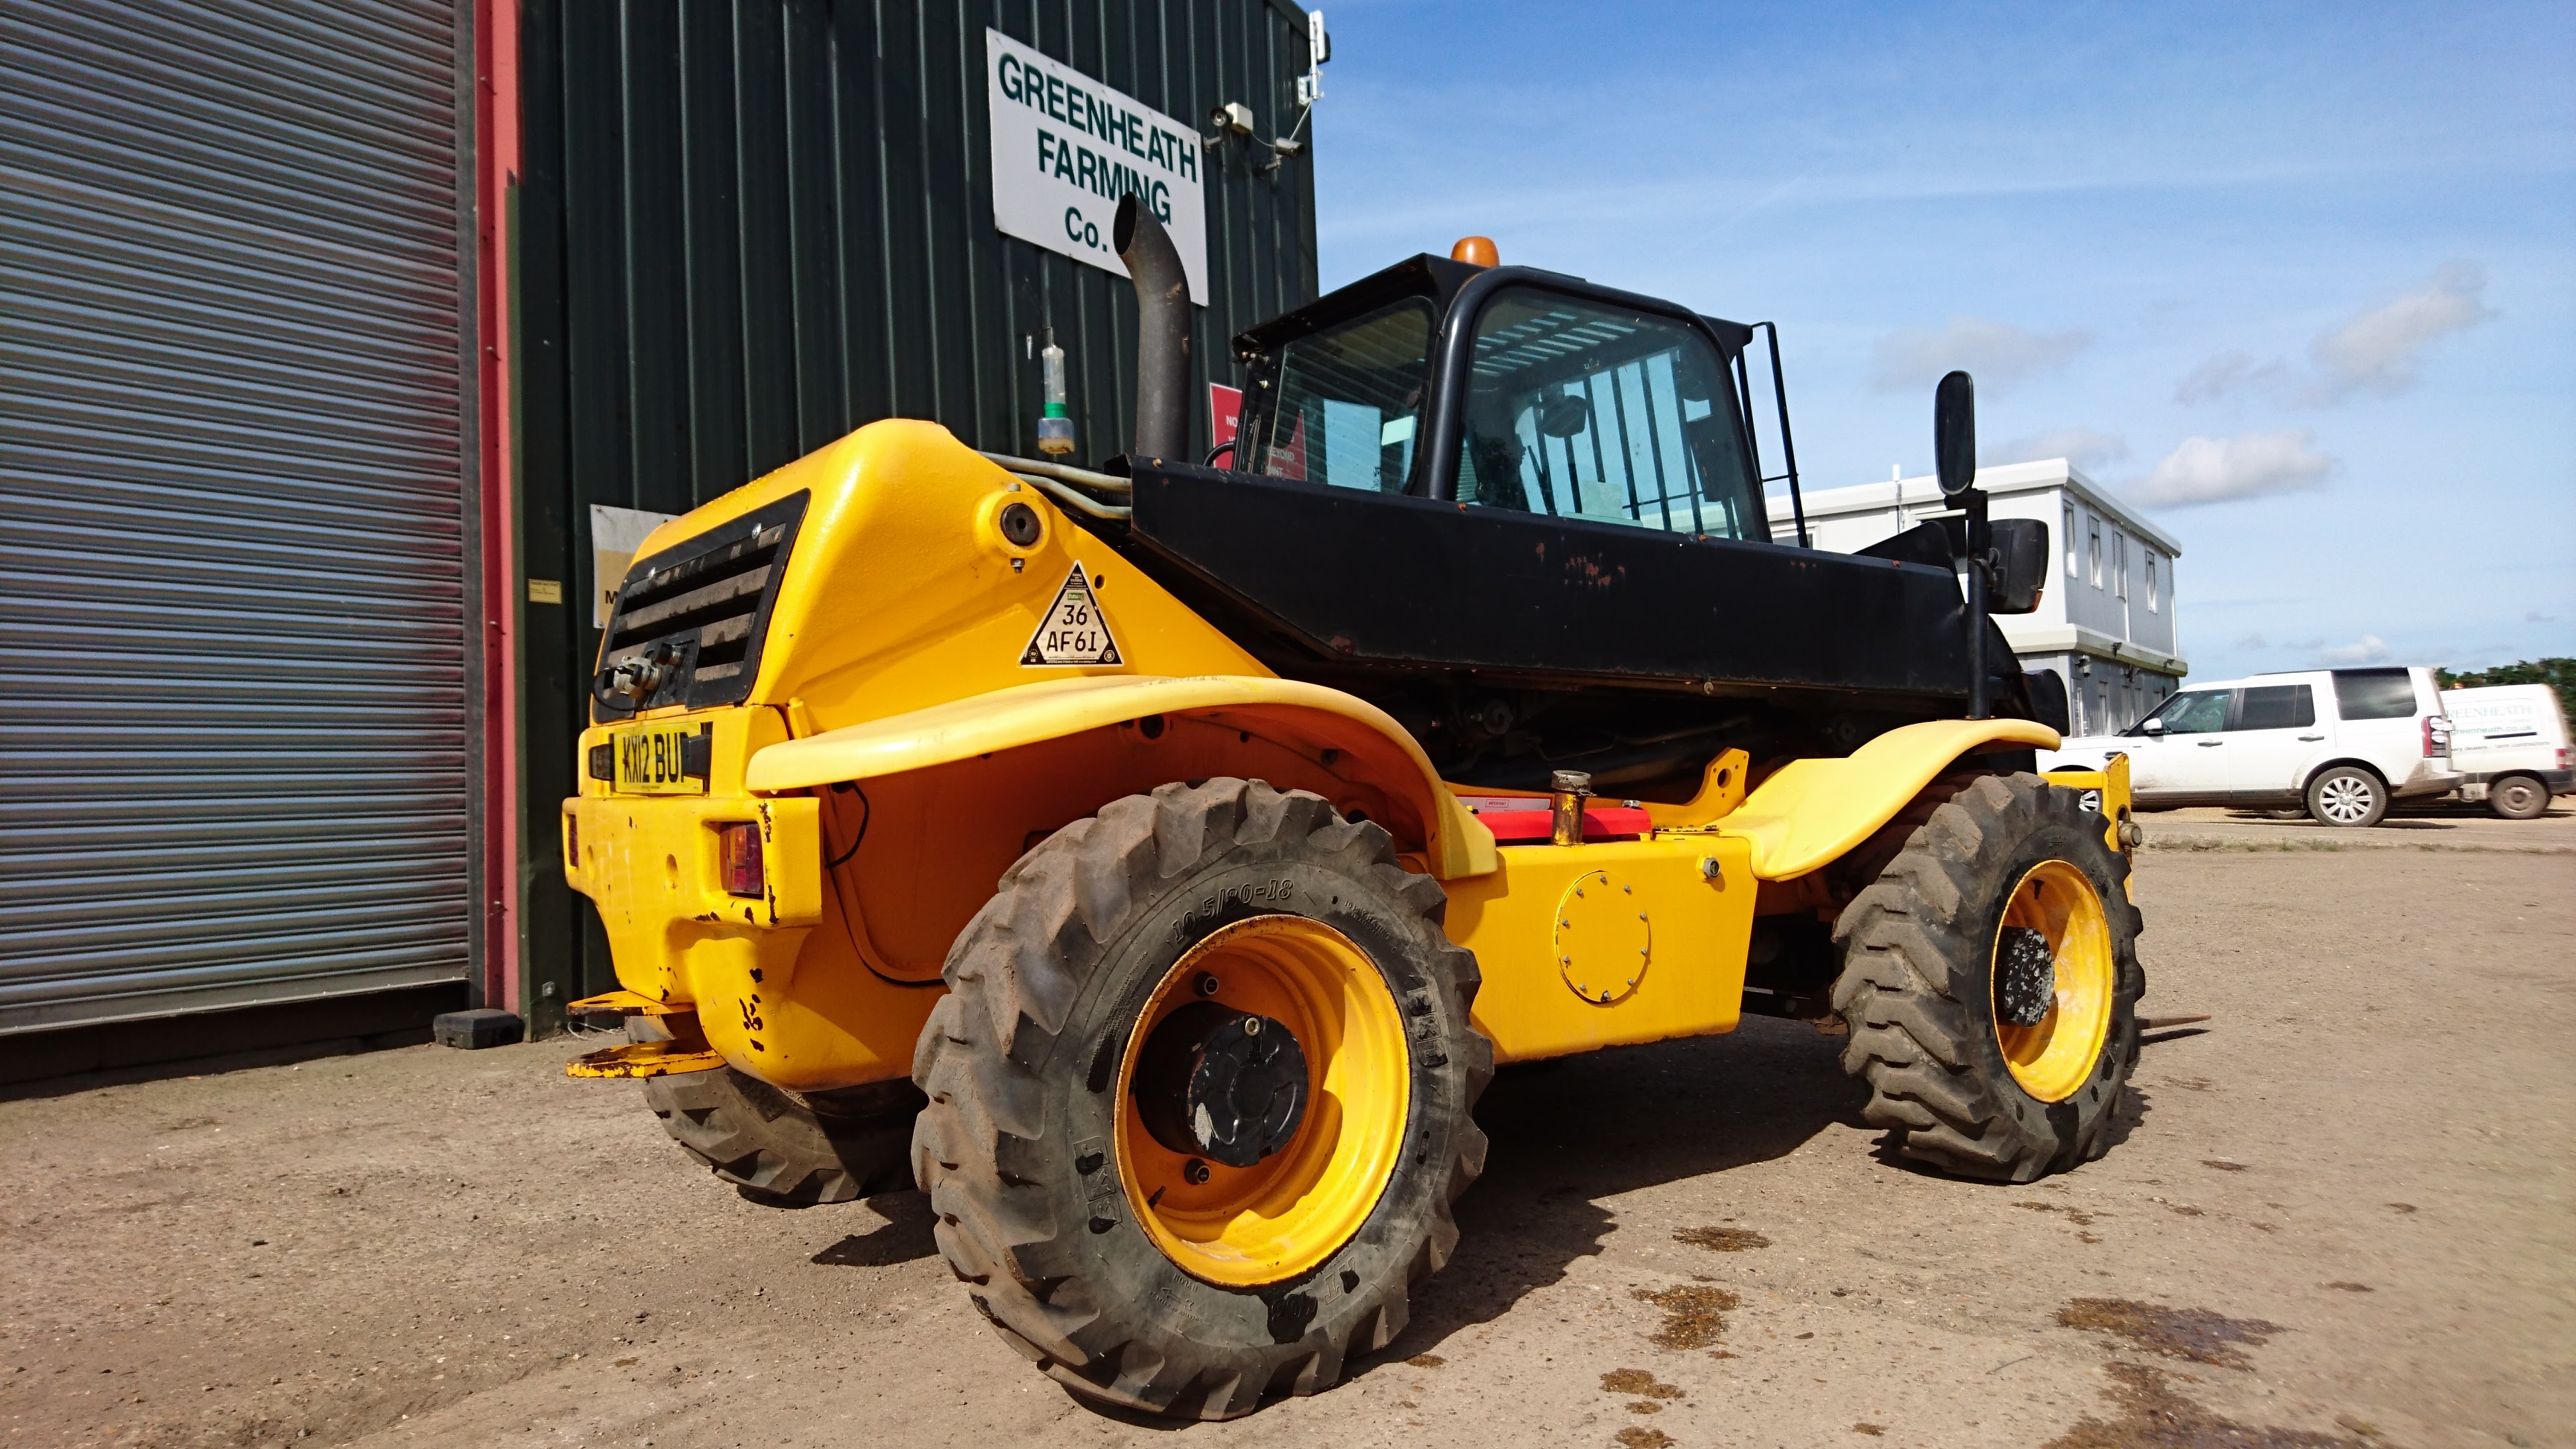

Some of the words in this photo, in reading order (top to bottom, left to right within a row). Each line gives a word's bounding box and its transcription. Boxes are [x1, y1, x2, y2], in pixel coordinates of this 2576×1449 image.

[998, 52, 1197, 183] GREENHEATH
[1037, 128, 1171, 225] FARMING
[1065, 206, 1108, 252] Co.
[1062, 604, 1088, 626] 36
[2446, 704, 2532, 719] REENHEATH
[623, 735, 651, 783] KX12
